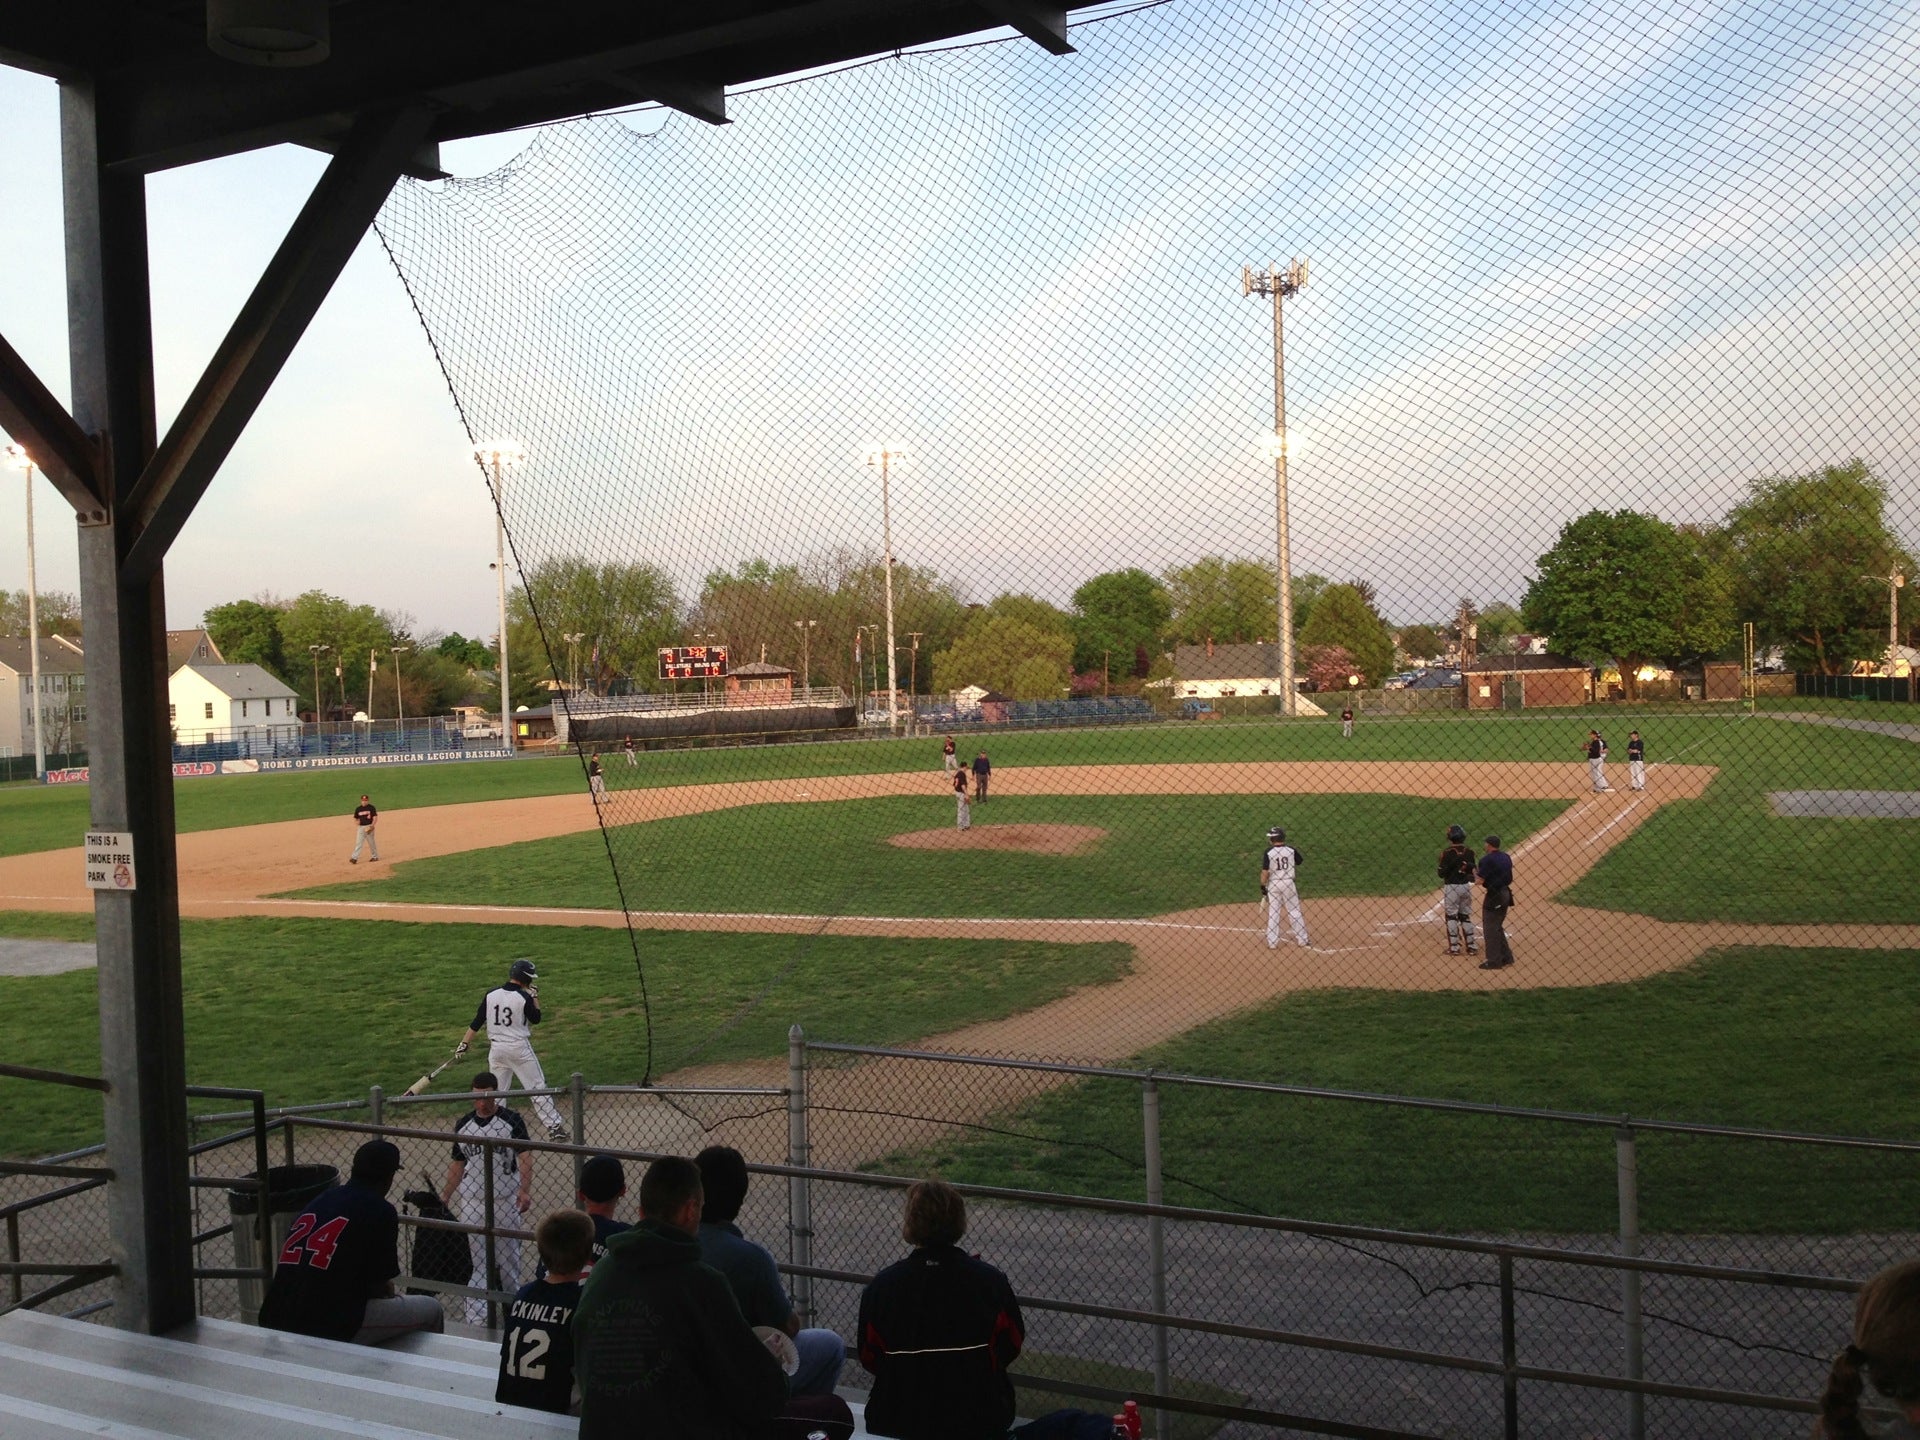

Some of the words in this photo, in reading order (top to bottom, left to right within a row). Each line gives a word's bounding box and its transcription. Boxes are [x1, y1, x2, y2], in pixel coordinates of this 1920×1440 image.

[262, 760, 292, 769] HOME
[295, 759, 309, 768] OF
[311, 756, 368, 767] FREDERICK
[371, 754, 424, 764] AMERICAN
[427, 751, 462, 761] LEGION
[465, 750, 513, 759] BASEBALL
[87, 835, 102, 846] THIS
[103, 835, 111, 846] IS
[112, 835, 118, 846] A
[88, 853, 111, 864] SMOKE
[112, 854, 131, 864] FREE
[1275, 856, 1289, 871] 18
[88, 871, 106, 882] PARK
[493, 1004, 513, 1027] 13
[278, 1212, 350, 1270] 24
[506, 1326, 551, 1380] 12
